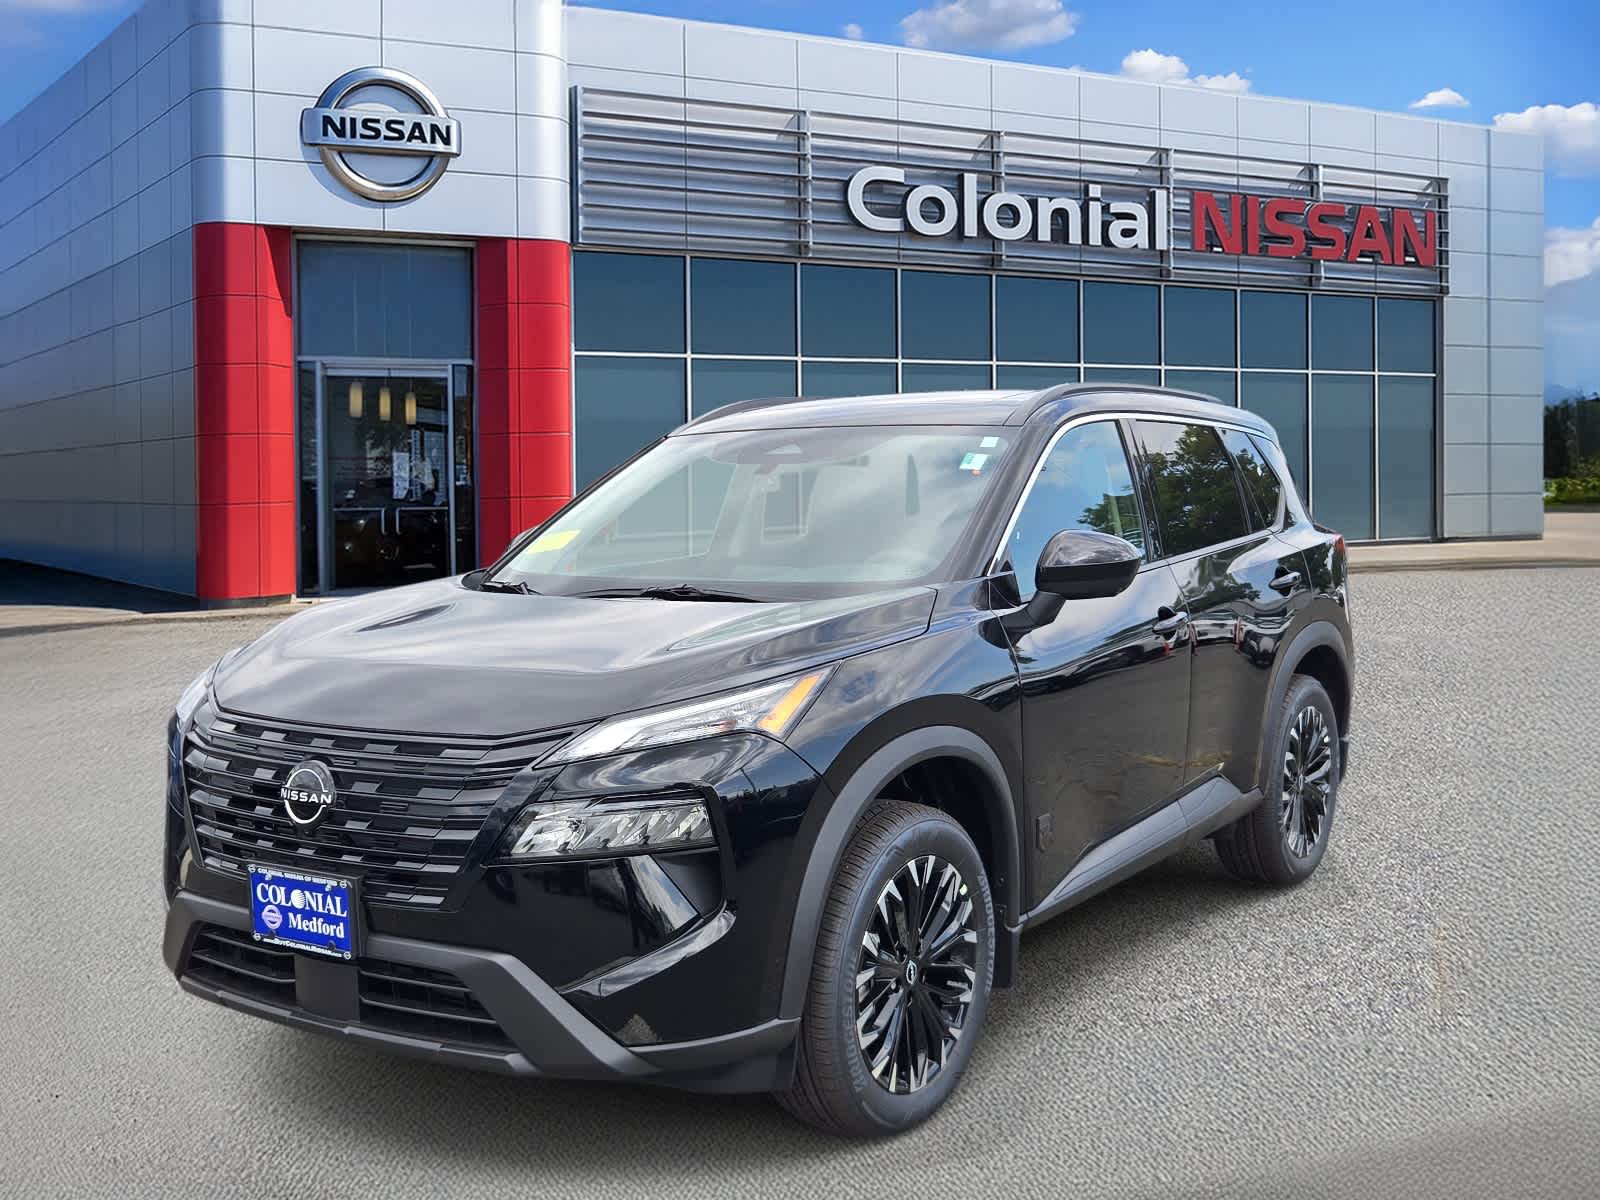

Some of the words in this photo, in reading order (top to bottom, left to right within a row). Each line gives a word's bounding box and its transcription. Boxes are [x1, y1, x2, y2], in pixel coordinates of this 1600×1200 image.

[322, 115, 452, 146] NISSAN
[847, 165, 1169, 250] Colonial
[1192, 190, 1437, 267] NISSAN
[280, 787, 332, 804] NISSAN
[256, 882, 348, 918] COLONIAL
[288, 911, 345, 939] Medford
